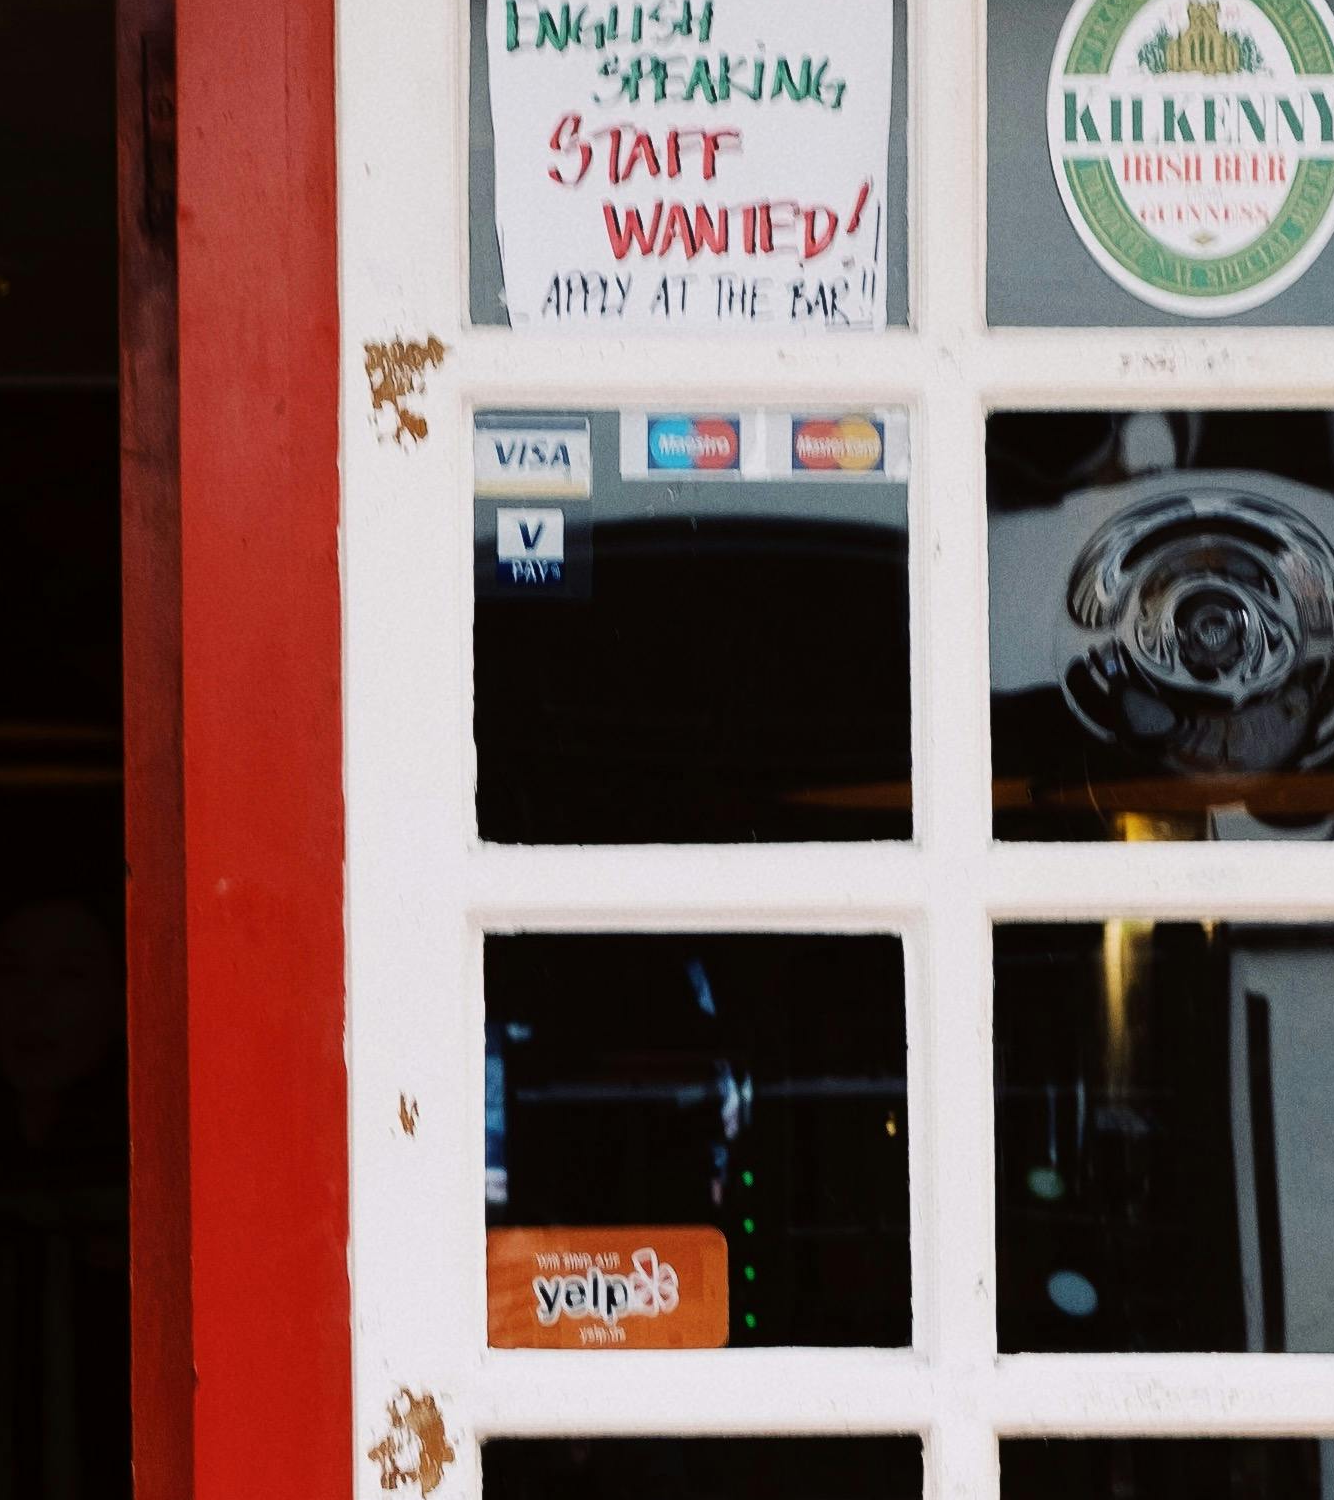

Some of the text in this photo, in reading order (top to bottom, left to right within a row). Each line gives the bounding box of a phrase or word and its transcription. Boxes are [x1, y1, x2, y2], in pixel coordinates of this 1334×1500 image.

[547, 111, 743, 188] STAFF
[1123, 153, 1287, 184] IRISH BEER
[602, 178, 872, 268] WANTED!
[1140, 202, 1271, 226] GUINNESS
[541, 270, 632, 319] APPLY
[651, 271, 698, 319] AT
[710, 272, 773, 320] THE
[494, 438, 572, 468] VISA
[658, 433, 731, 457] Maestro
[517, 518, 545, 551] V
[511, 559, 548, 583] PAY
[534, 1267, 629, 1326] yelp
